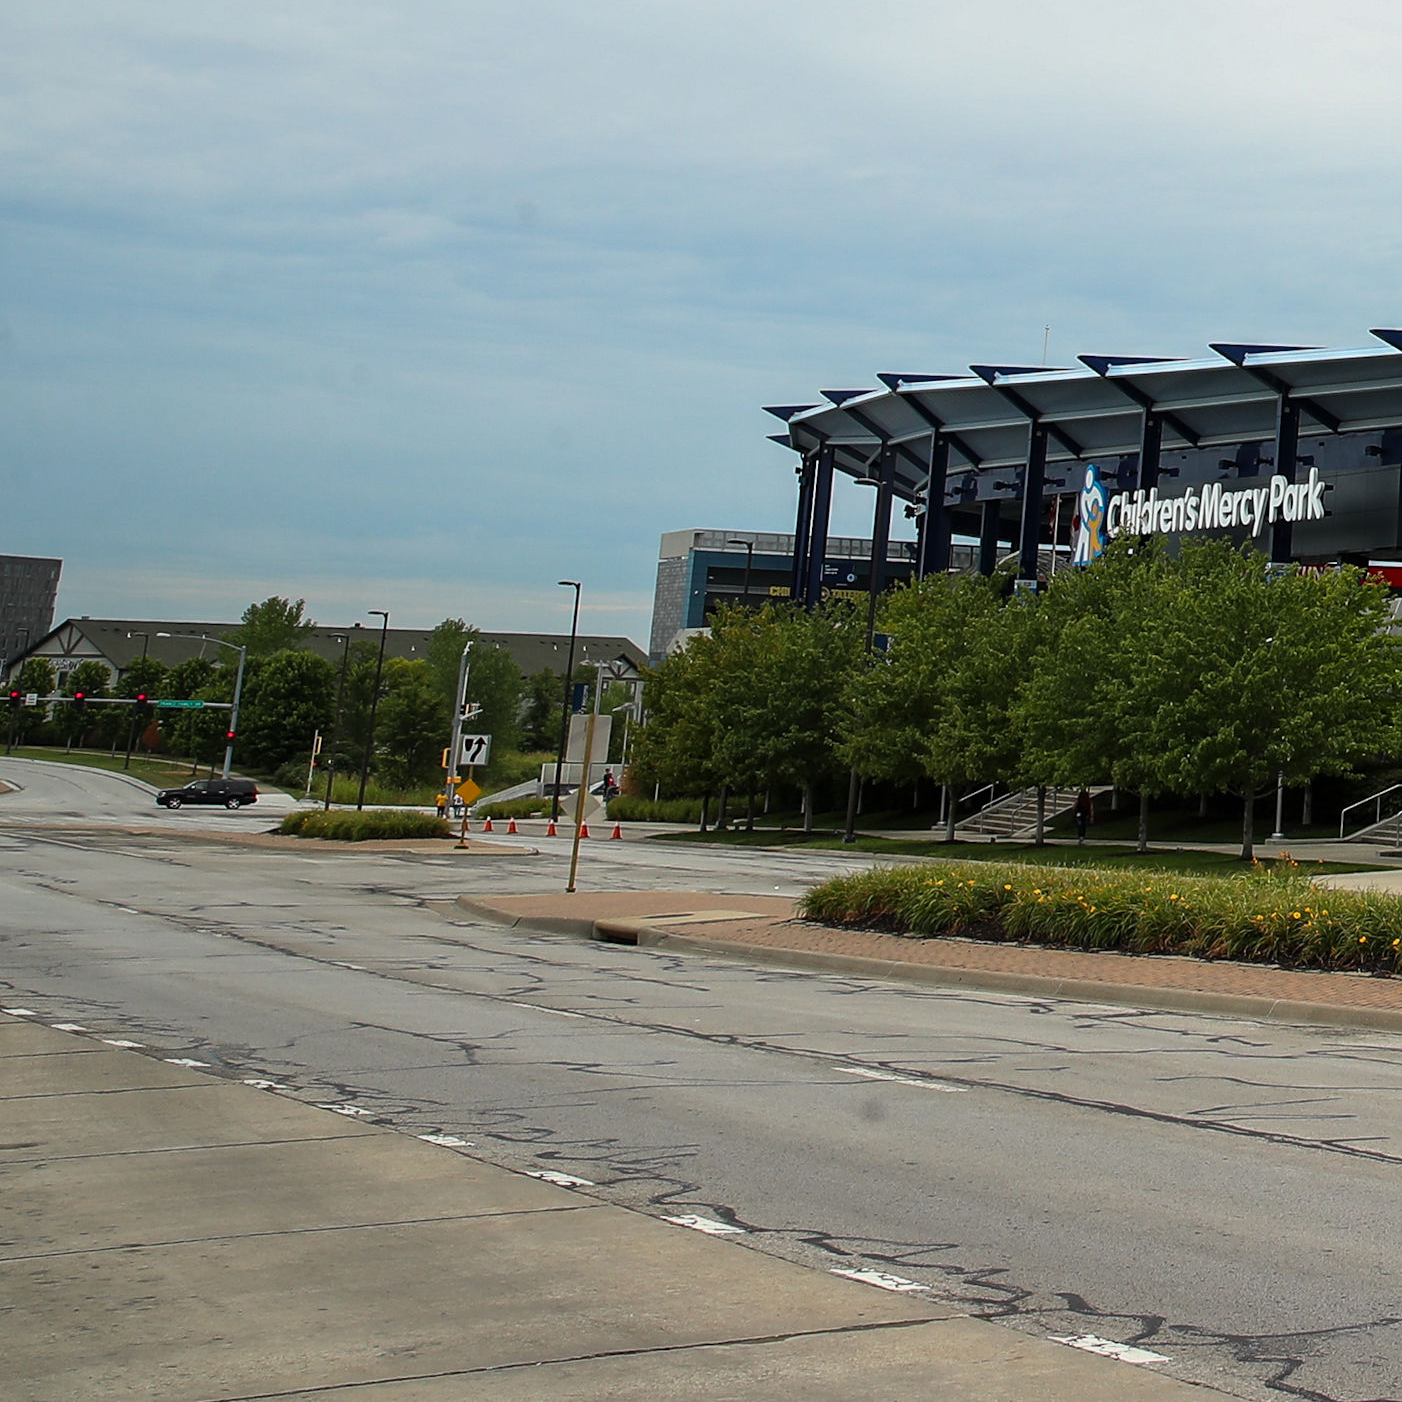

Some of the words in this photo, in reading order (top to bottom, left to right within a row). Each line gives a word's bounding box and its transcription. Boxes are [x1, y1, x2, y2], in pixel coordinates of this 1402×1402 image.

[1106, 486, 1200, 540] Children's
[1198, 482, 1269, 538] Mercy
[1269, 466, 1326, 524] Park
